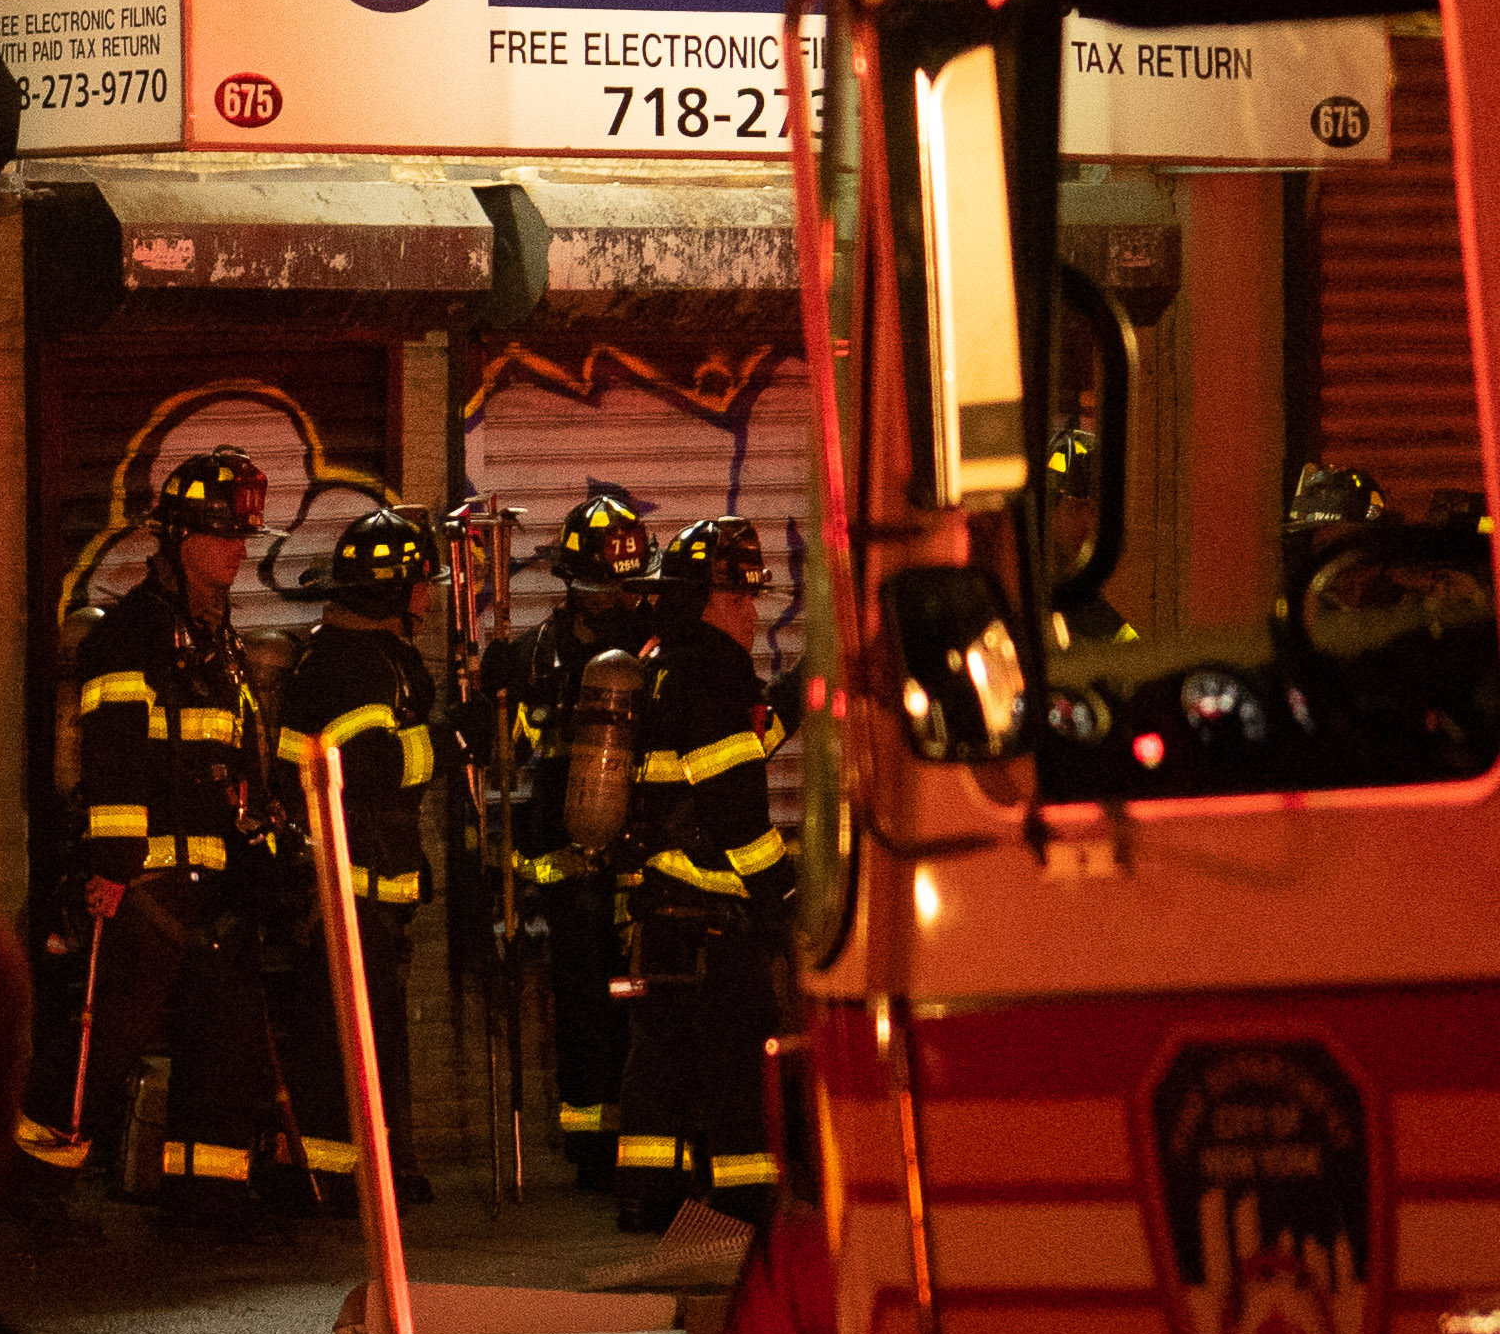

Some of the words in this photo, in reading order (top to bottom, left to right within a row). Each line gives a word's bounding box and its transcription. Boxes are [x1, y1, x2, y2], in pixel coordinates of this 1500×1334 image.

[24, 8, 115, 36] ELECTRONIC
[120, 5, 168, 30] FILING
[32, 39, 64, 62] PAID
[69, 37, 97, 60] TAX
[102, 33, 161, 58] RETURN
[488, 29, 569, 67] FREE
[583, 32, 779, 69] ELECTRONIC
[1070, 41, 1125, 75] TAX
[1137, 44, 1252, 80] RETURN
[20, 68, 168, 111] 8-273-9770
[223, 82, 274, 119] 675
[1318, 105, 1361, 140] 675
